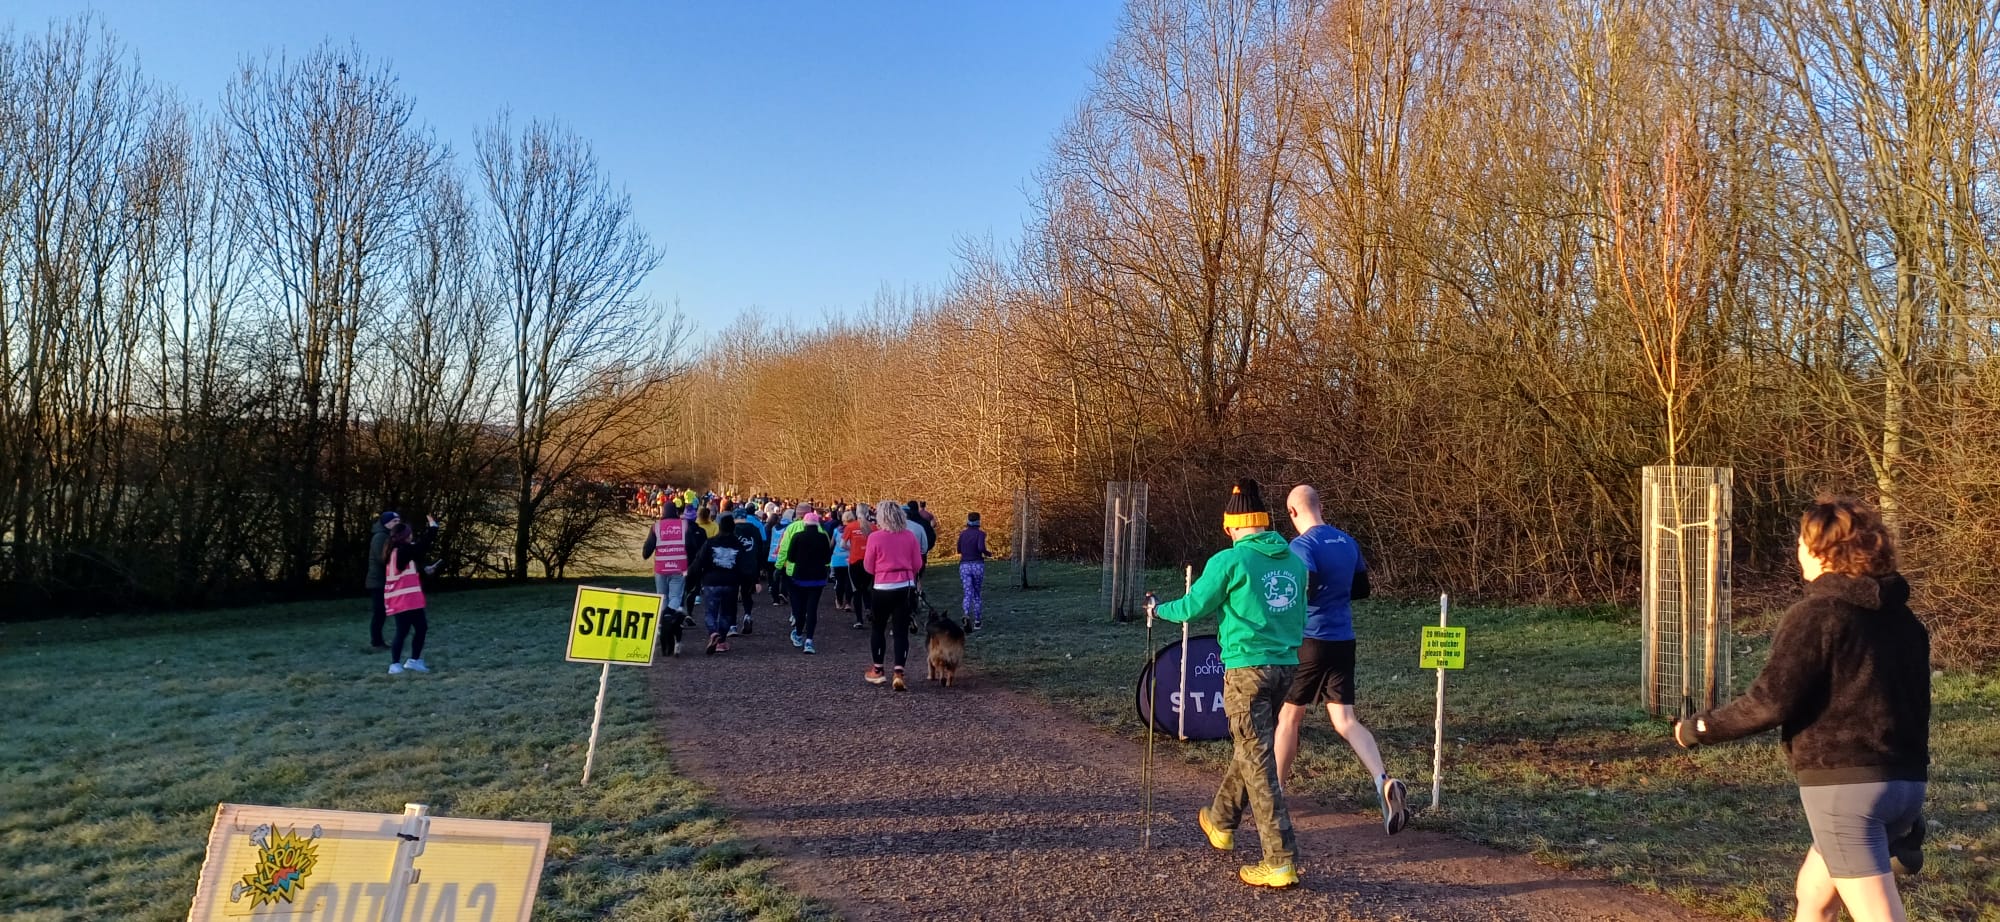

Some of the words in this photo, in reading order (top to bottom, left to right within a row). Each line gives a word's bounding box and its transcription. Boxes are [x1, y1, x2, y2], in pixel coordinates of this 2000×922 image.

[579, 607, 654, 641] START
[1425, 649, 1441, 658] please
[1170, 692, 1224, 713] STA
